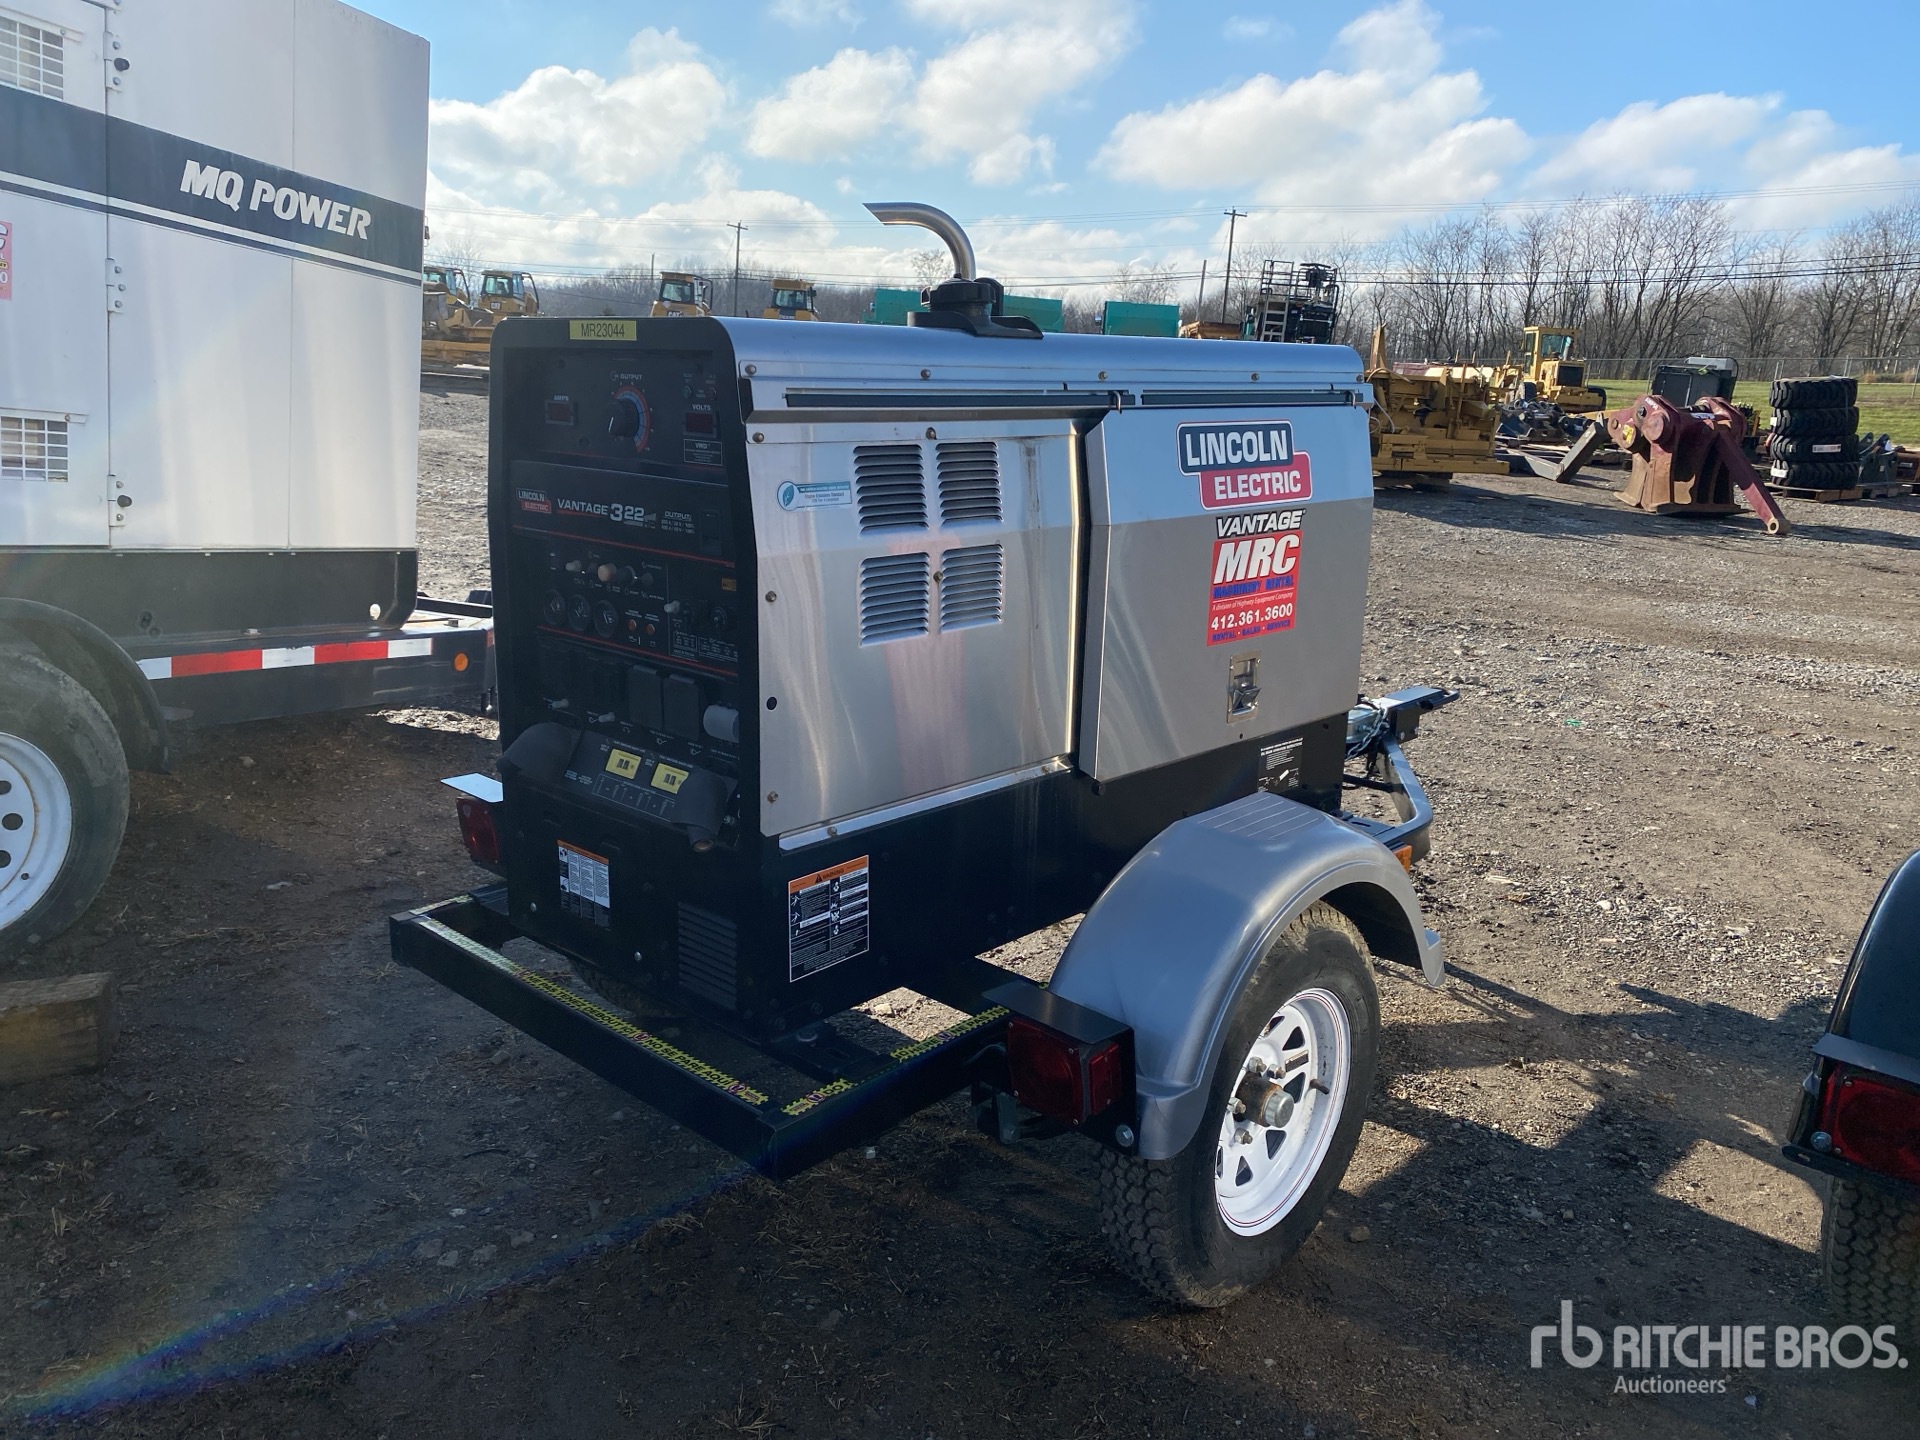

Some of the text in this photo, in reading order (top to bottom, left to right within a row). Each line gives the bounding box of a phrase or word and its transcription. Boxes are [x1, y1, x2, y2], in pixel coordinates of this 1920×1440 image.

[180, 159, 371, 240] MQ POWER
[581, 324, 625, 338] MR23044
[620, 373, 642, 381] OUTPUT
[1185, 430, 1288, 466] LINCOLN
[518, 490, 545, 502] LINCOLN
[1214, 470, 1301, 500] ELECTRIC
[524, 502, 549, 512] ELECTRIC
[557, 498, 645, 522] VANTAGE 322
[664, 510, 691, 520] OUTPUT
[1216, 510, 1303, 538] VANTAGE
[1213, 533, 1299, 585] MRC
[1213, 575, 1294, 600] MACHINERY RENTAL
[1211, 603, 1293, 631] 412.361.3600
[528, 975, 542, 983] NE
[541, 982, 558, 993] PAS
[584, 1006, 622, 1028] DEBOUT
[622, 1027, 637, 1035] ICI
[646, 1039, 663, 1049] NO
[661, 1048, 677, 1057] SE
[676, 1055, 706, 1072] PARE
